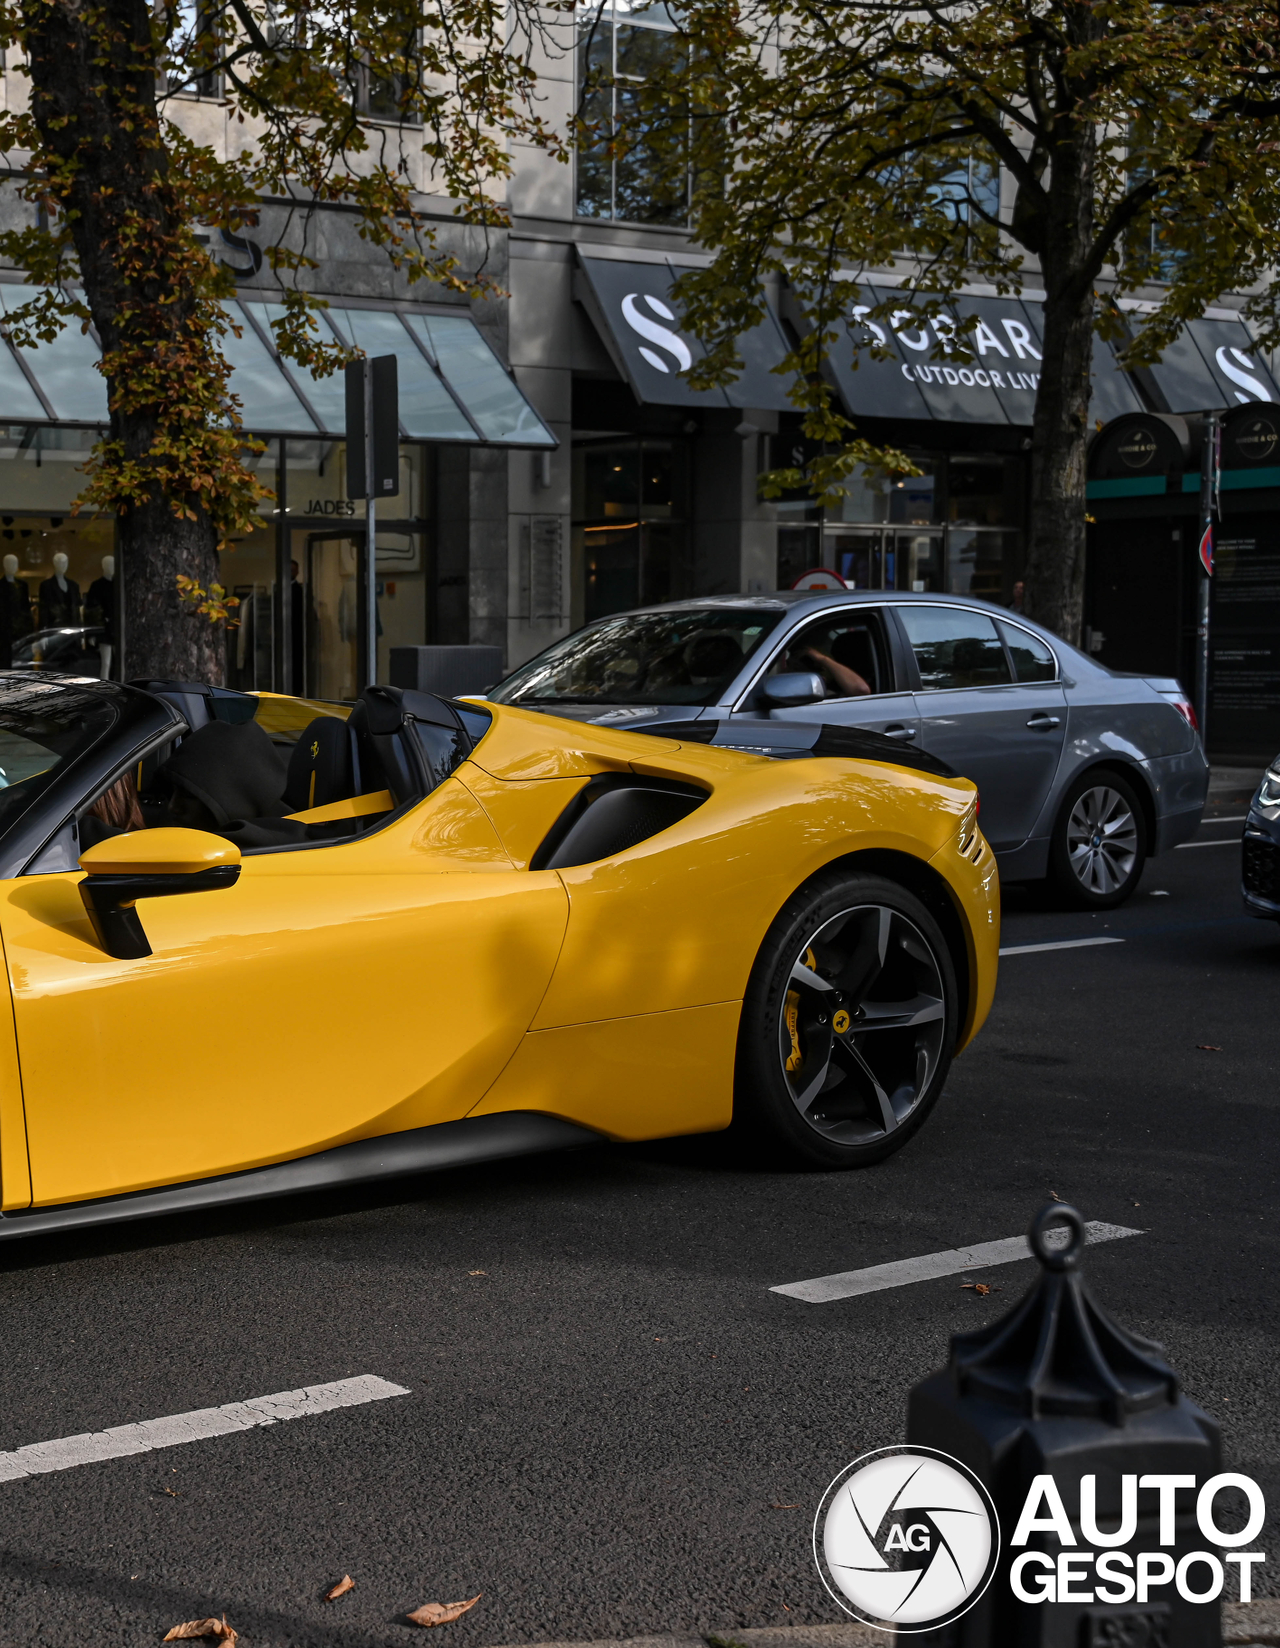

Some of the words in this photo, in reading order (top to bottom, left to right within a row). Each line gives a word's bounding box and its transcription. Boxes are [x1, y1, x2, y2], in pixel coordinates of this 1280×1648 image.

[852, 305, 1043, 360] SORAR
[901, 363, 1006, 388] OUTDOOR
[1006, 371, 1041, 390] LIV
[303, 499, 355, 516] JADES
